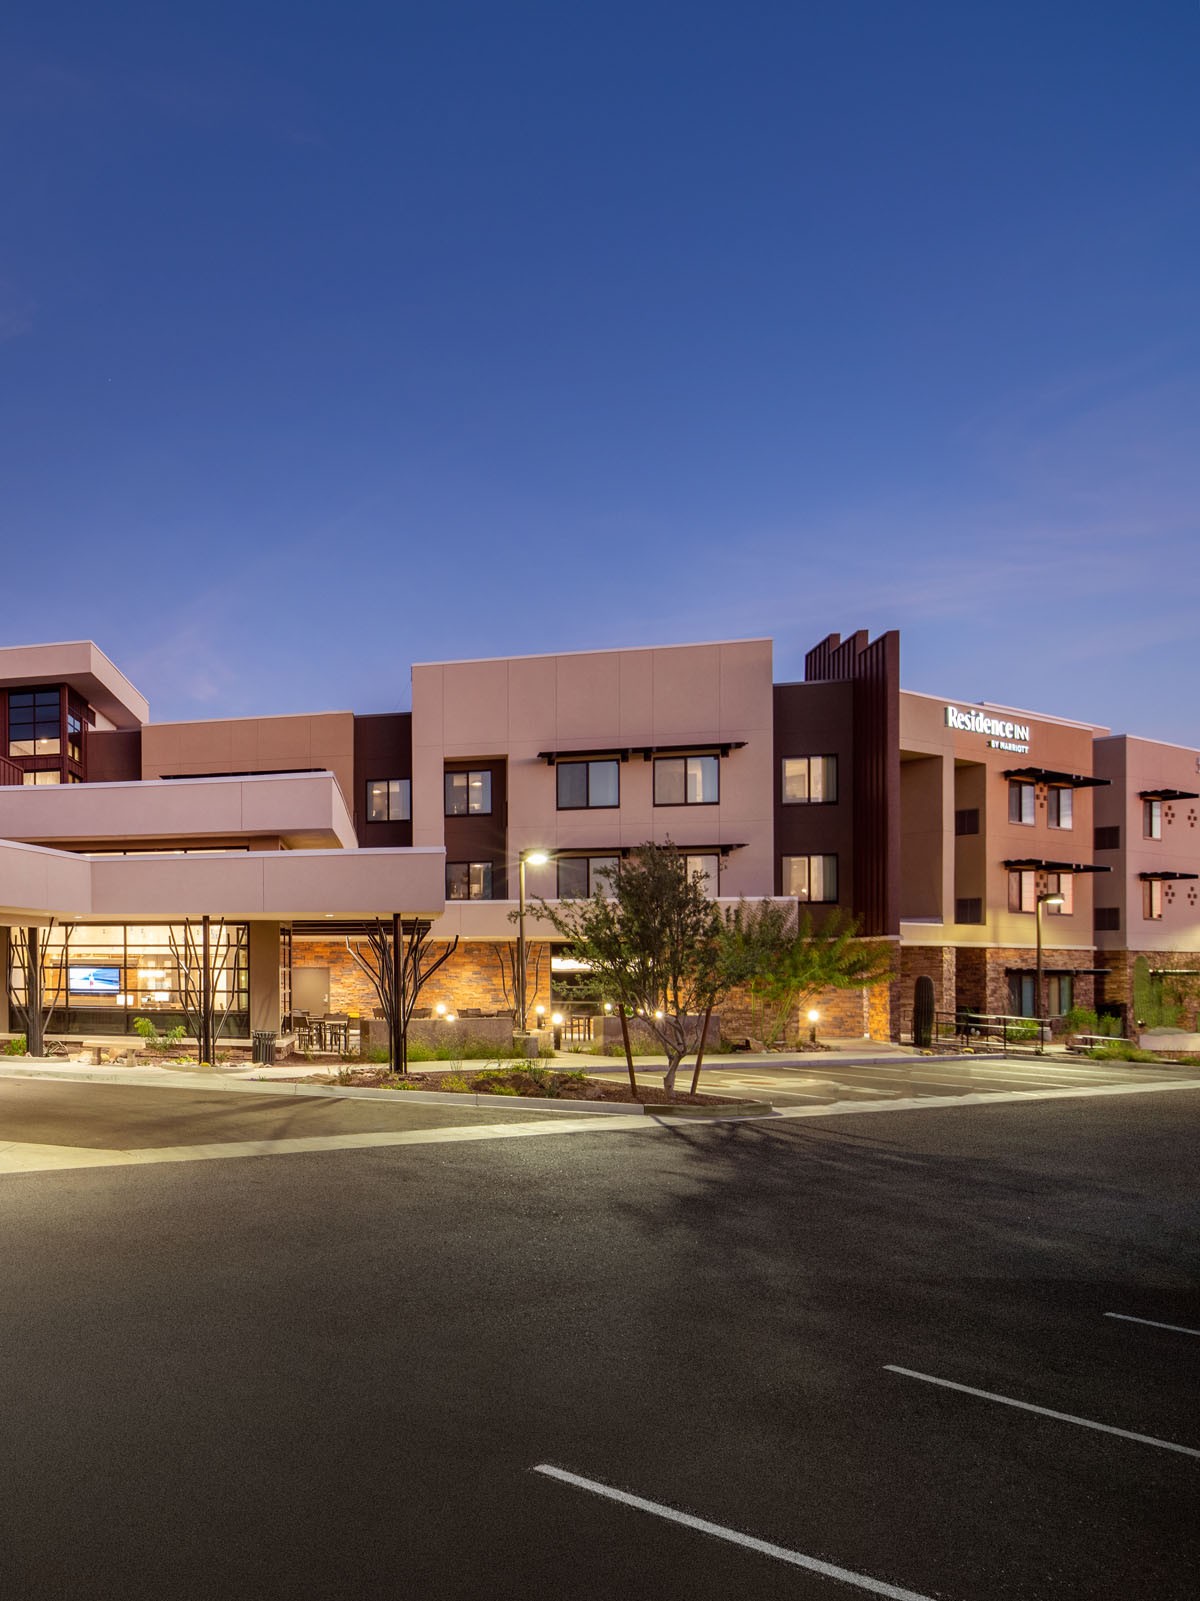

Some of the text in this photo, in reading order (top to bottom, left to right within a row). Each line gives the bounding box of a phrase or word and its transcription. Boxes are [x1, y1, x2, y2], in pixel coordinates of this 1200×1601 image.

[947, 706, 1030, 741] Residence INN
[1000, 741, 1029, 754] MARRIOTT
